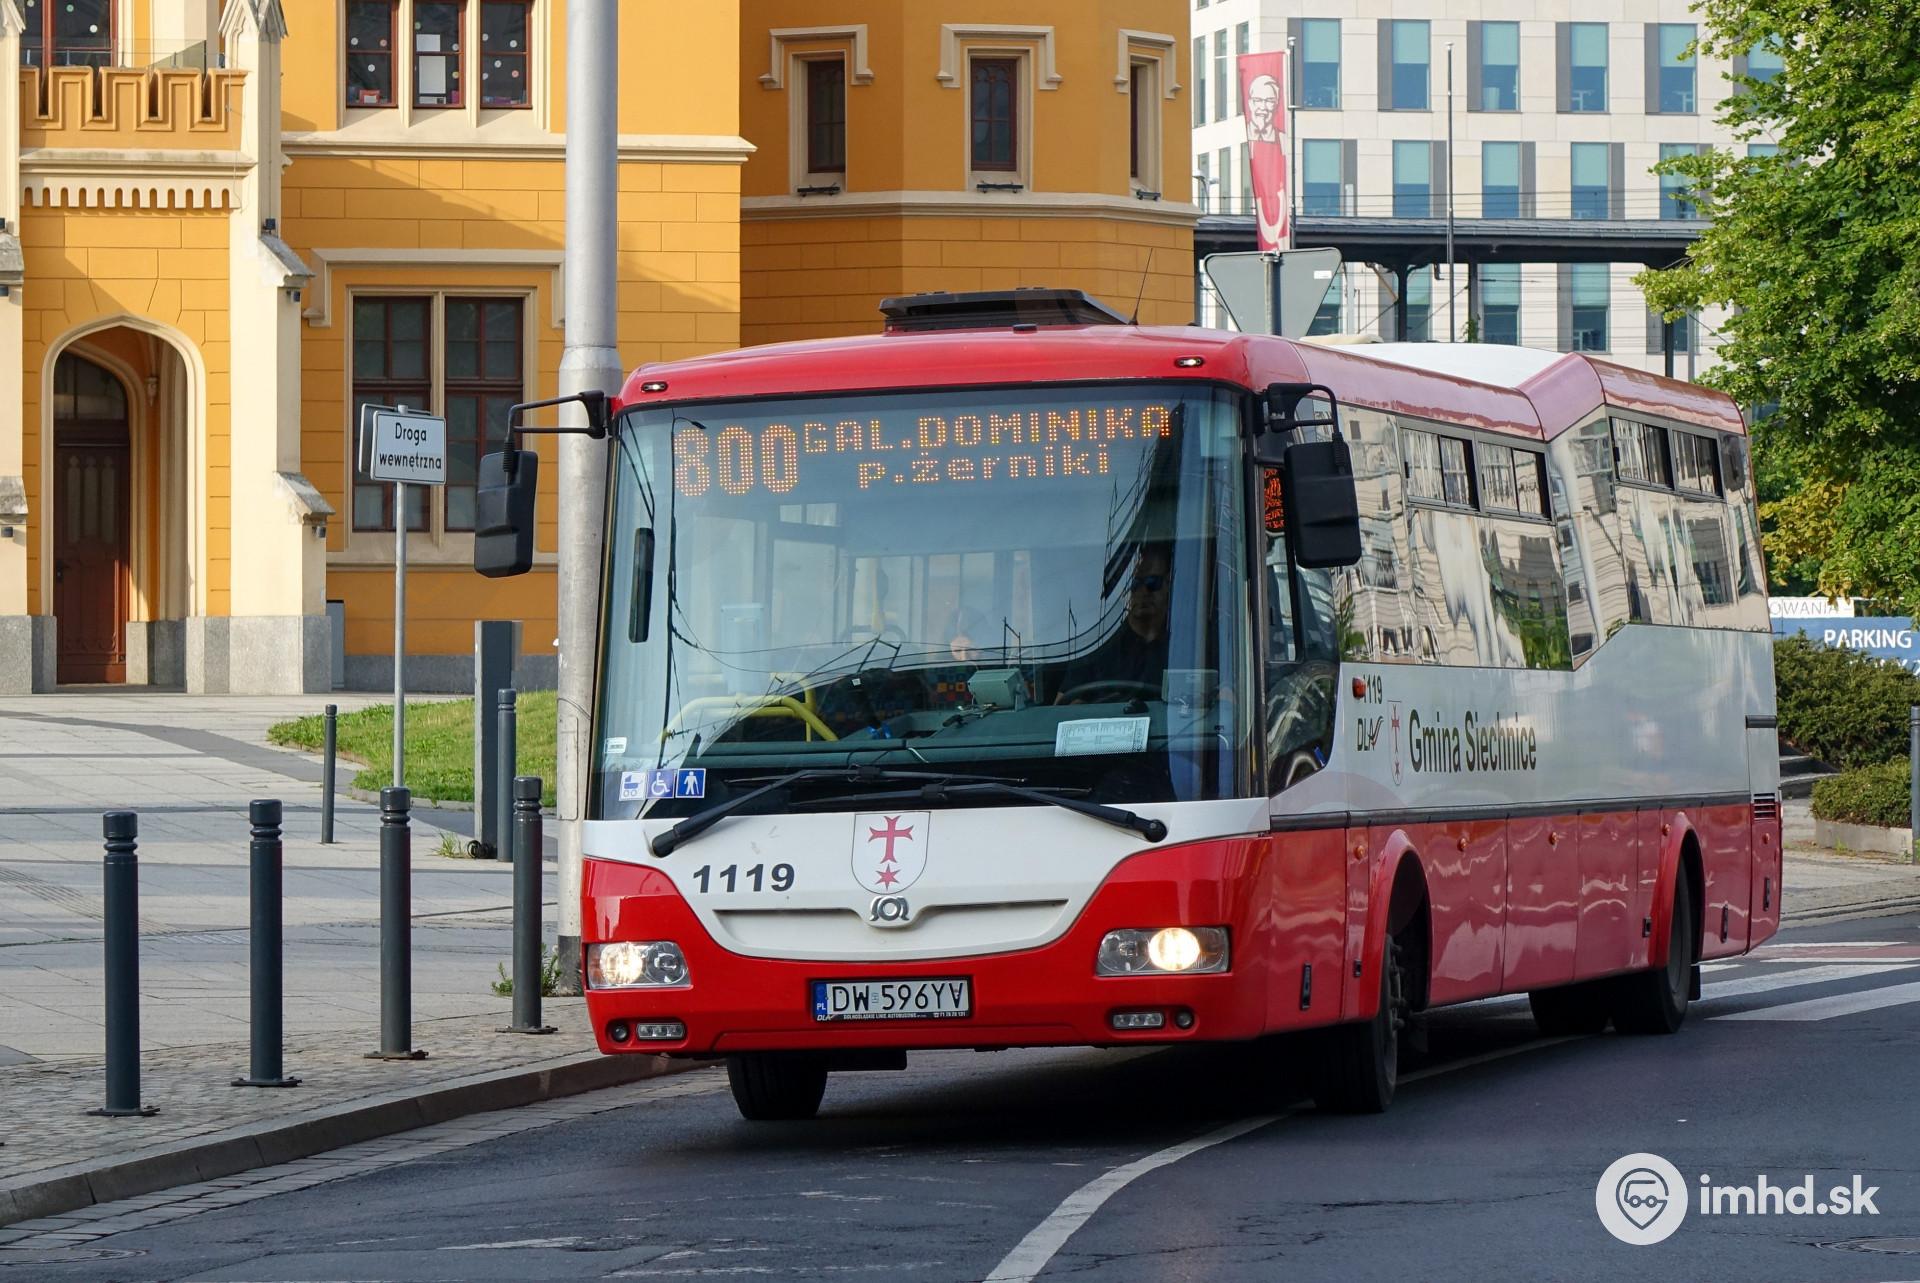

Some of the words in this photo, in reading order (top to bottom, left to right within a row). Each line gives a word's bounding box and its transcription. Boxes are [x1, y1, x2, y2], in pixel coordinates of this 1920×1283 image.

[395, 422, 427, 446] Droga
[804, 405, 1171, 454] GAL.DOMINIKA
[379, 451, 442, 473] wewnętrzna
[673, 424, 798, 497] 800
[1824, 629, 1912, 648] PARKING
[1409, 709, 1461, 773] Gmina
[1465, 710, 1537, 773] Siechnice
[692, 863, 795, 894] 1119
[816, 1002, 827, 1011] PL
[831, 984, 870, 1012] DW
[881, 982, 964, 1010] 596YV
